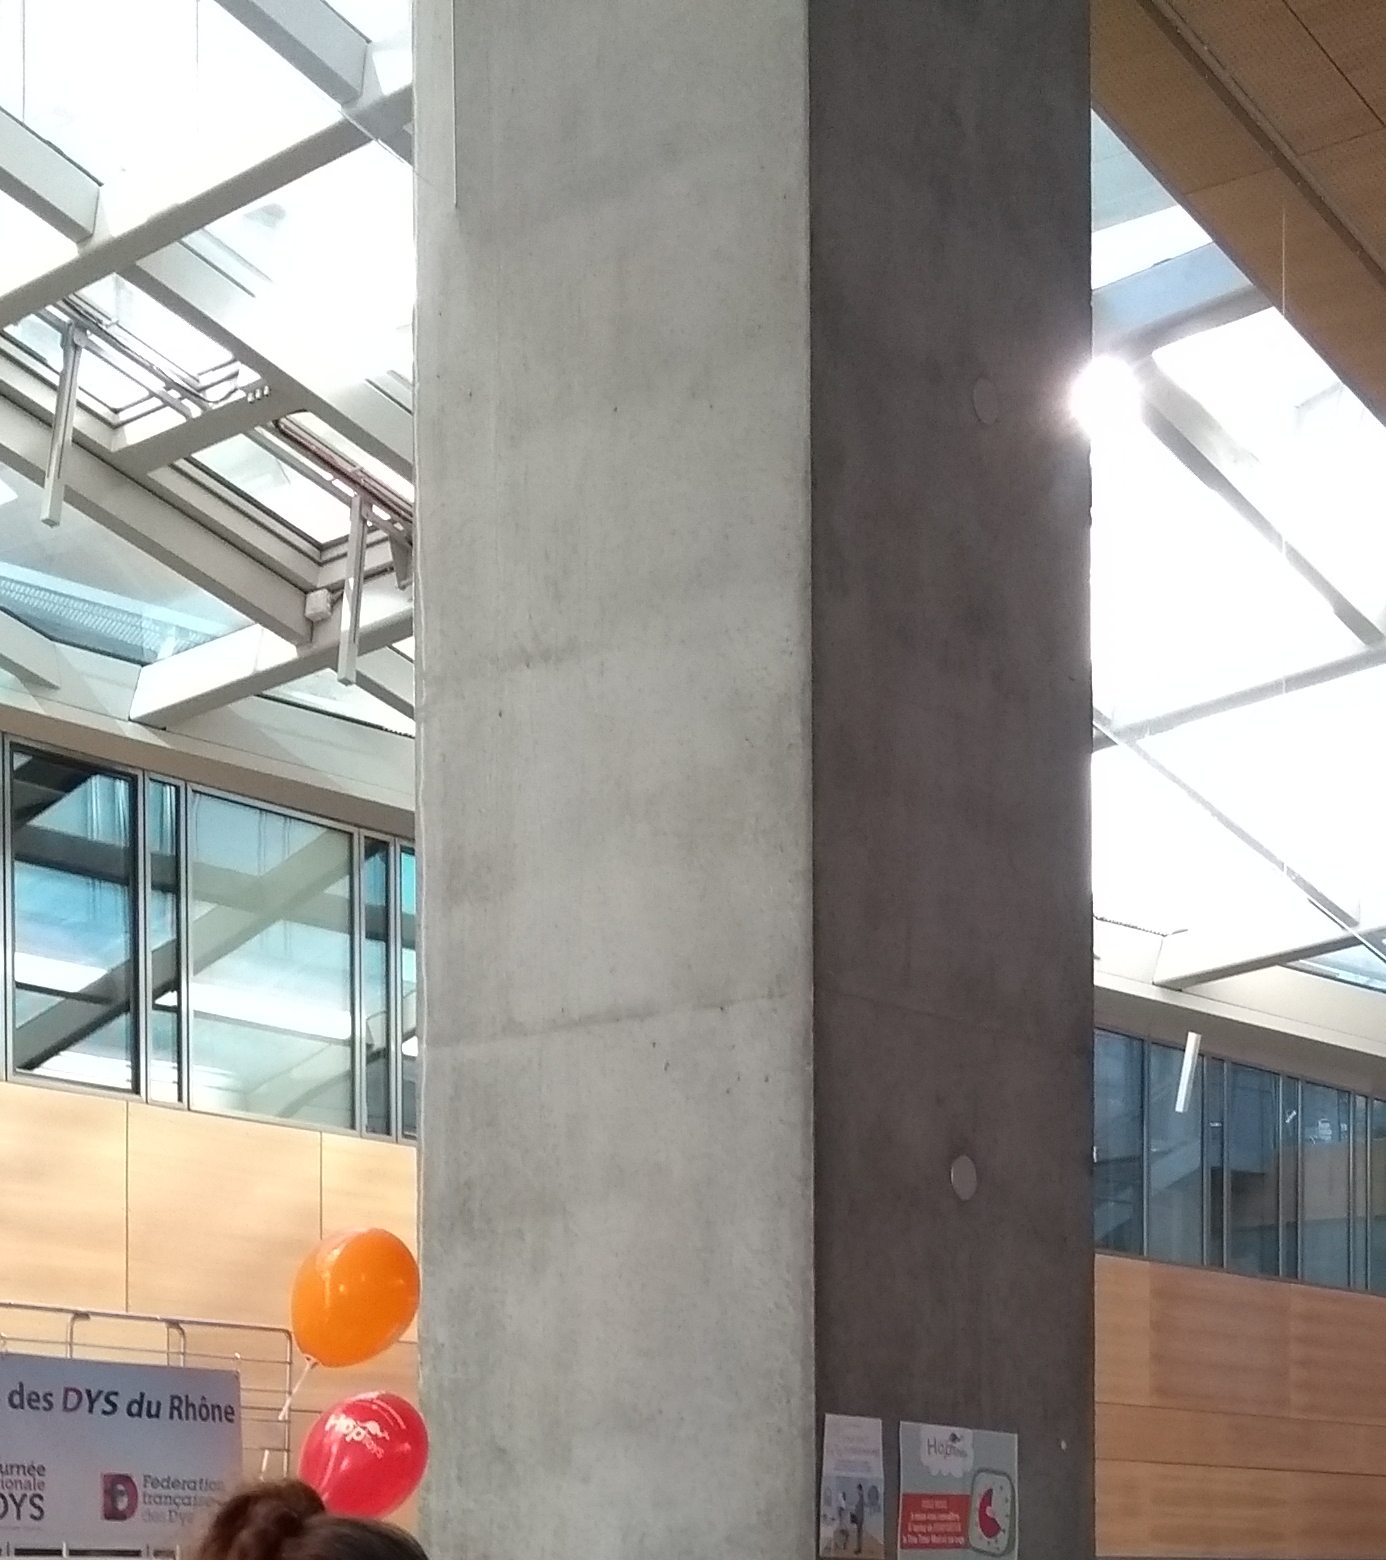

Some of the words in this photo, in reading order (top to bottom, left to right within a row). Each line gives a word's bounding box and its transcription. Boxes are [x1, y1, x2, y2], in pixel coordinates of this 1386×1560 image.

[8, 1382, 55, 1412] des
[63, 1387, 120, 1416] DYS
[127, 1392, 162, 1420] du
[168, 1395, 236, 1423] Rhône
